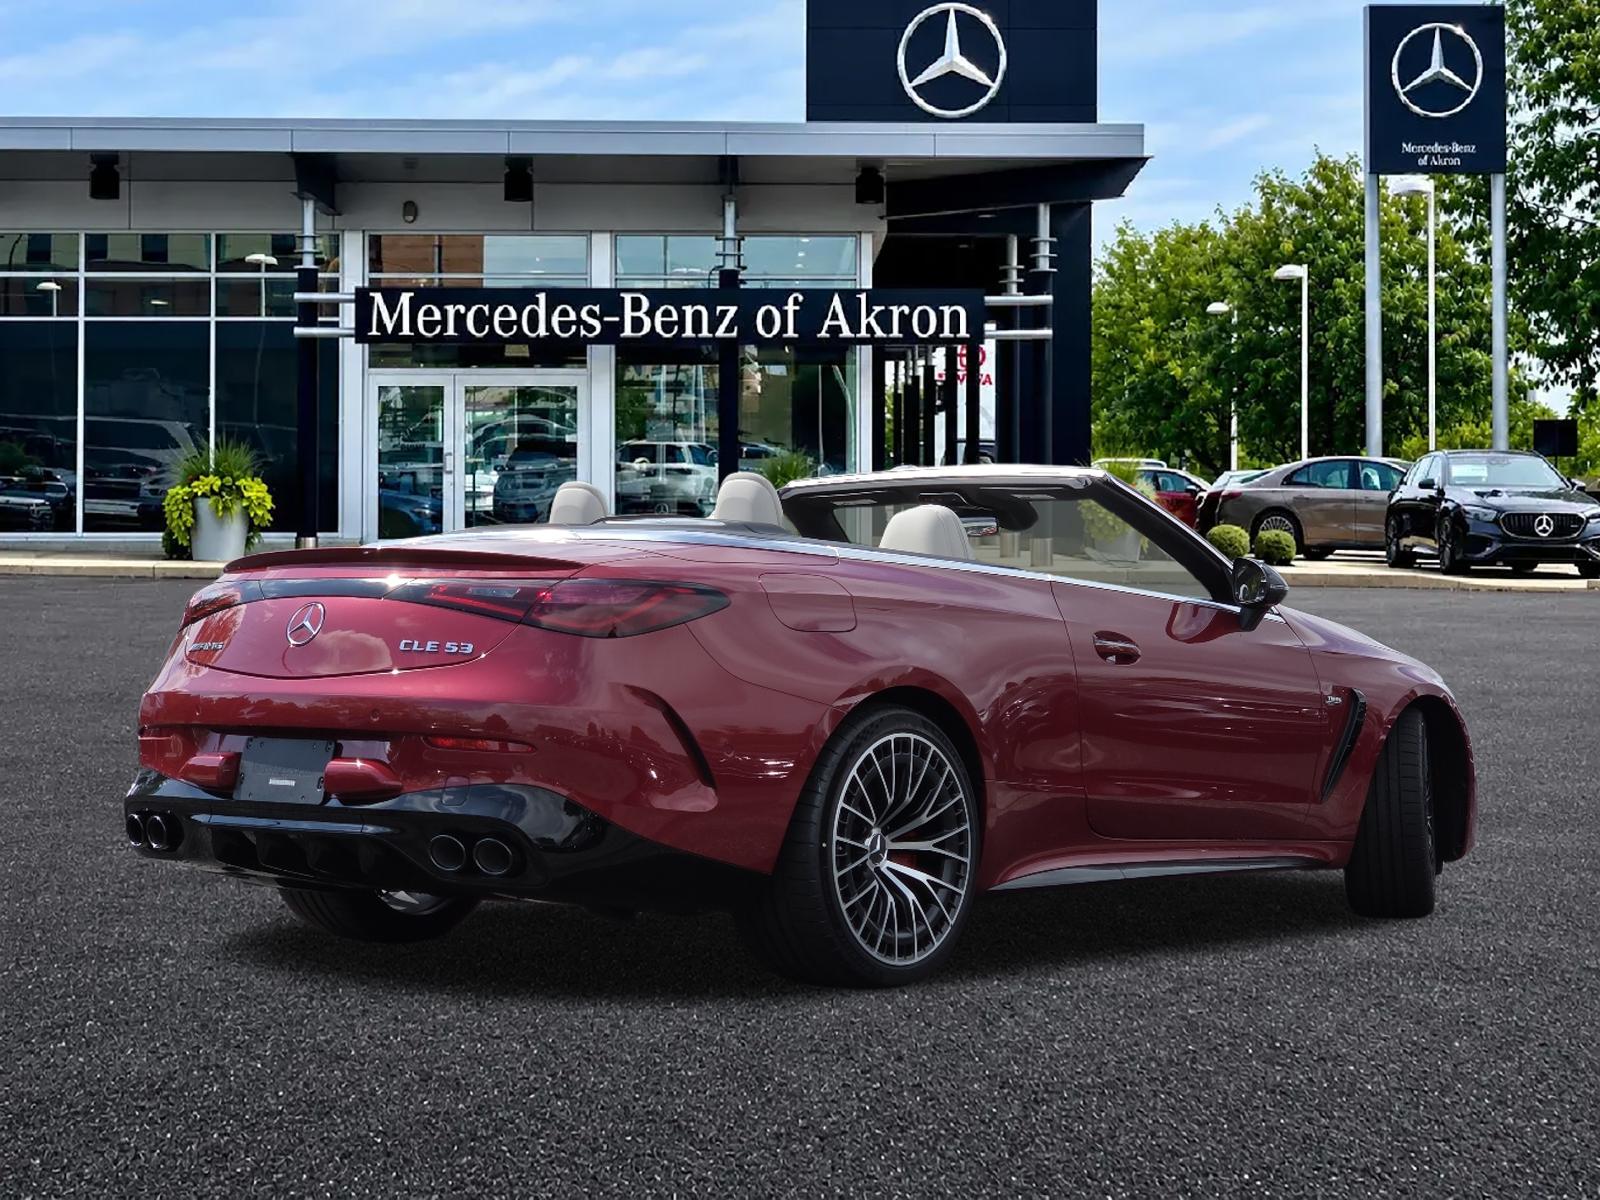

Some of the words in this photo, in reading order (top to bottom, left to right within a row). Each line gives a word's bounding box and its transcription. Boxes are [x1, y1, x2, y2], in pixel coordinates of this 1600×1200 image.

[1401, 141, 1476, 153] Mercedes-Benz
[1417, 154, 1429, 166] of
[1430, 154, 1461, 166] Akron
[367, 291, 738, 338] Mercedes-Benz
[756, 293, 804, 338] of
[817, 292, 970, 338] Akron
[399, 639, 440, 653] CLE
[444, 641, 474, 654] 53
